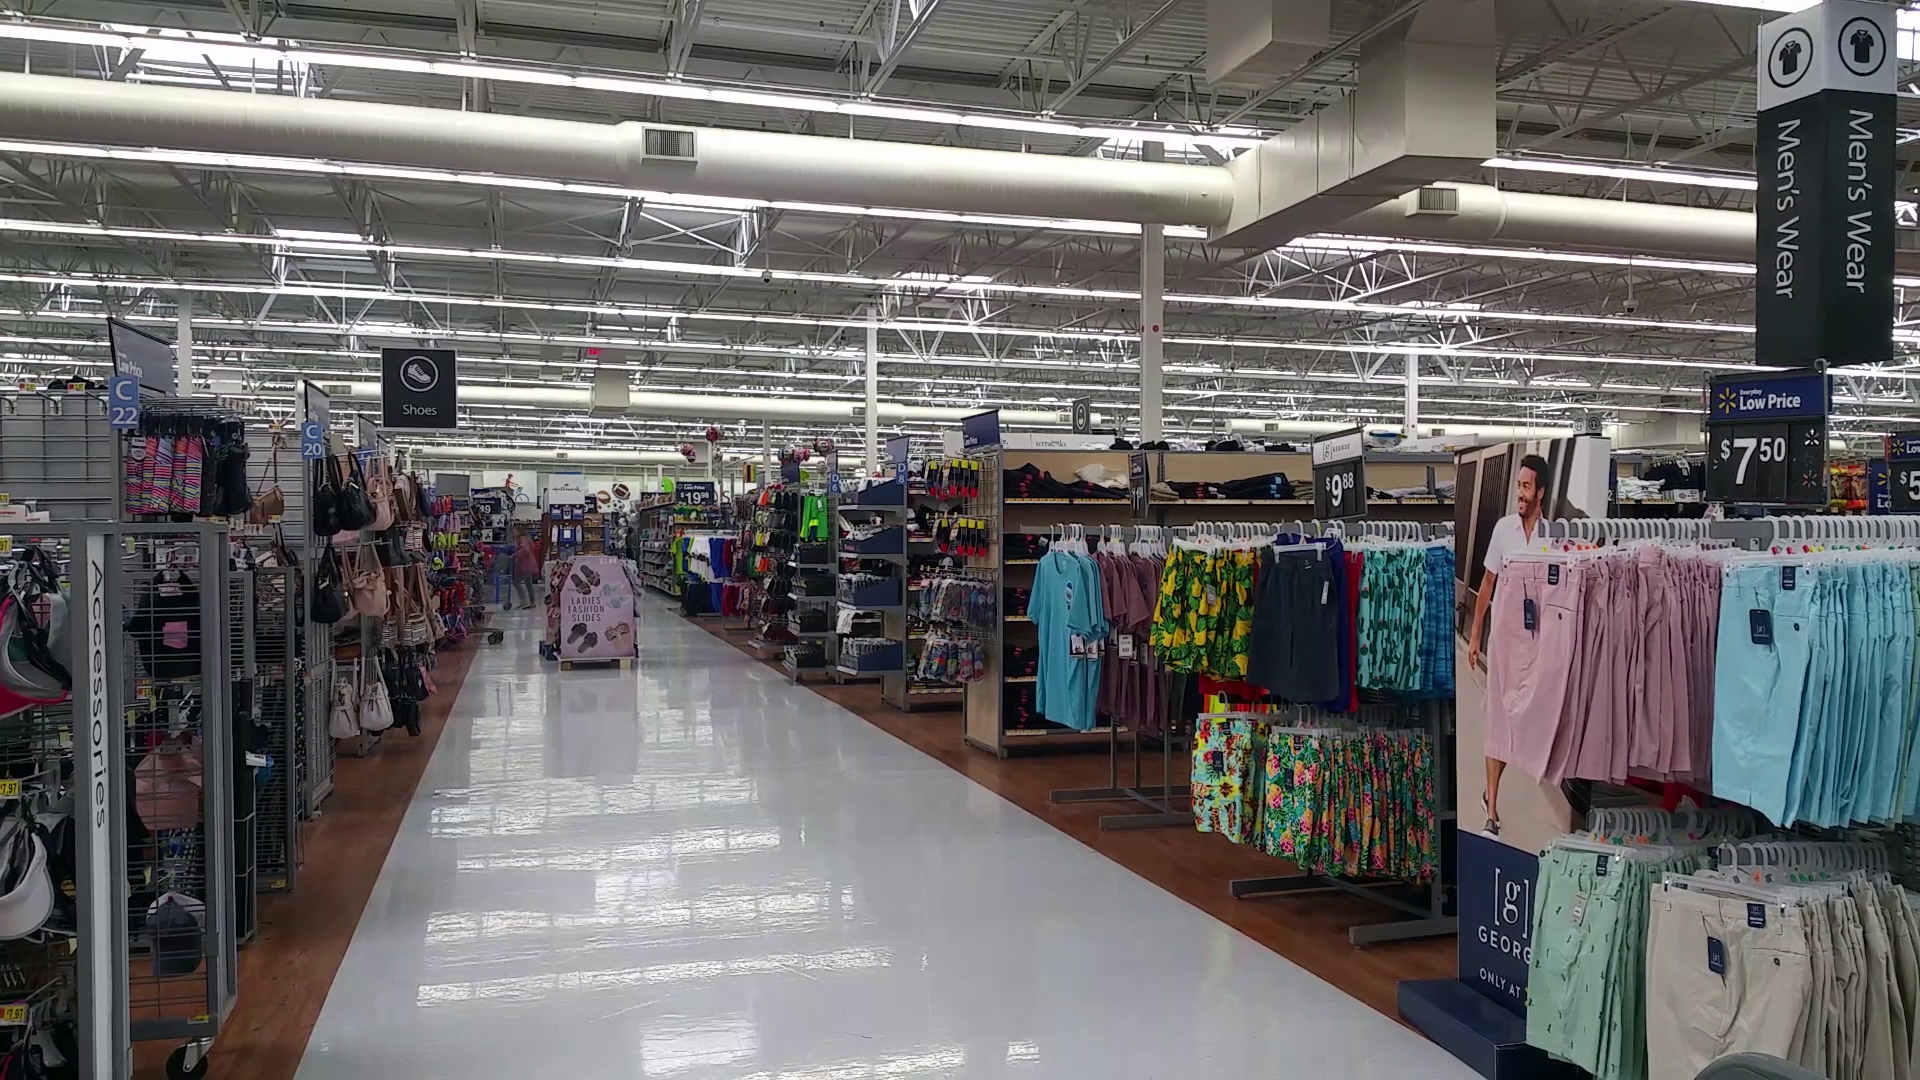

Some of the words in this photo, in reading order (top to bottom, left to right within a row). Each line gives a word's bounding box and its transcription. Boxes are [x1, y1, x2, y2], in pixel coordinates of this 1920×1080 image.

[1848, 109, 1873, 202] Men's
[1777, 119, 1800, 212] Men's
[1776, 215, 1800, 299] Wear
[1846, 211, 1872, 293] Wear
[115, 380, 133, 400] C
[403, 404, 437, 416] Shoes
[1740, 396, 1766, 410] Low
[1768, 393, 1801, 409] Price
[112, 407, 138, 424] 22
[306, 425, 318, 439] C
[304, 443, 322, 456] 20
[898, 464, 906, 472] D
[568, 605, 605, 613] FASHION
[571, 597, 602, 605] LADIES
[571, 614, 602, 622] SLIDES
[91, 560, 105, 829] Accessories
[1478, 926, 1531, 964] GEORG
[1480, 968, 1506, 990] ONLY
[1509, 983, 1521, 998] AT
